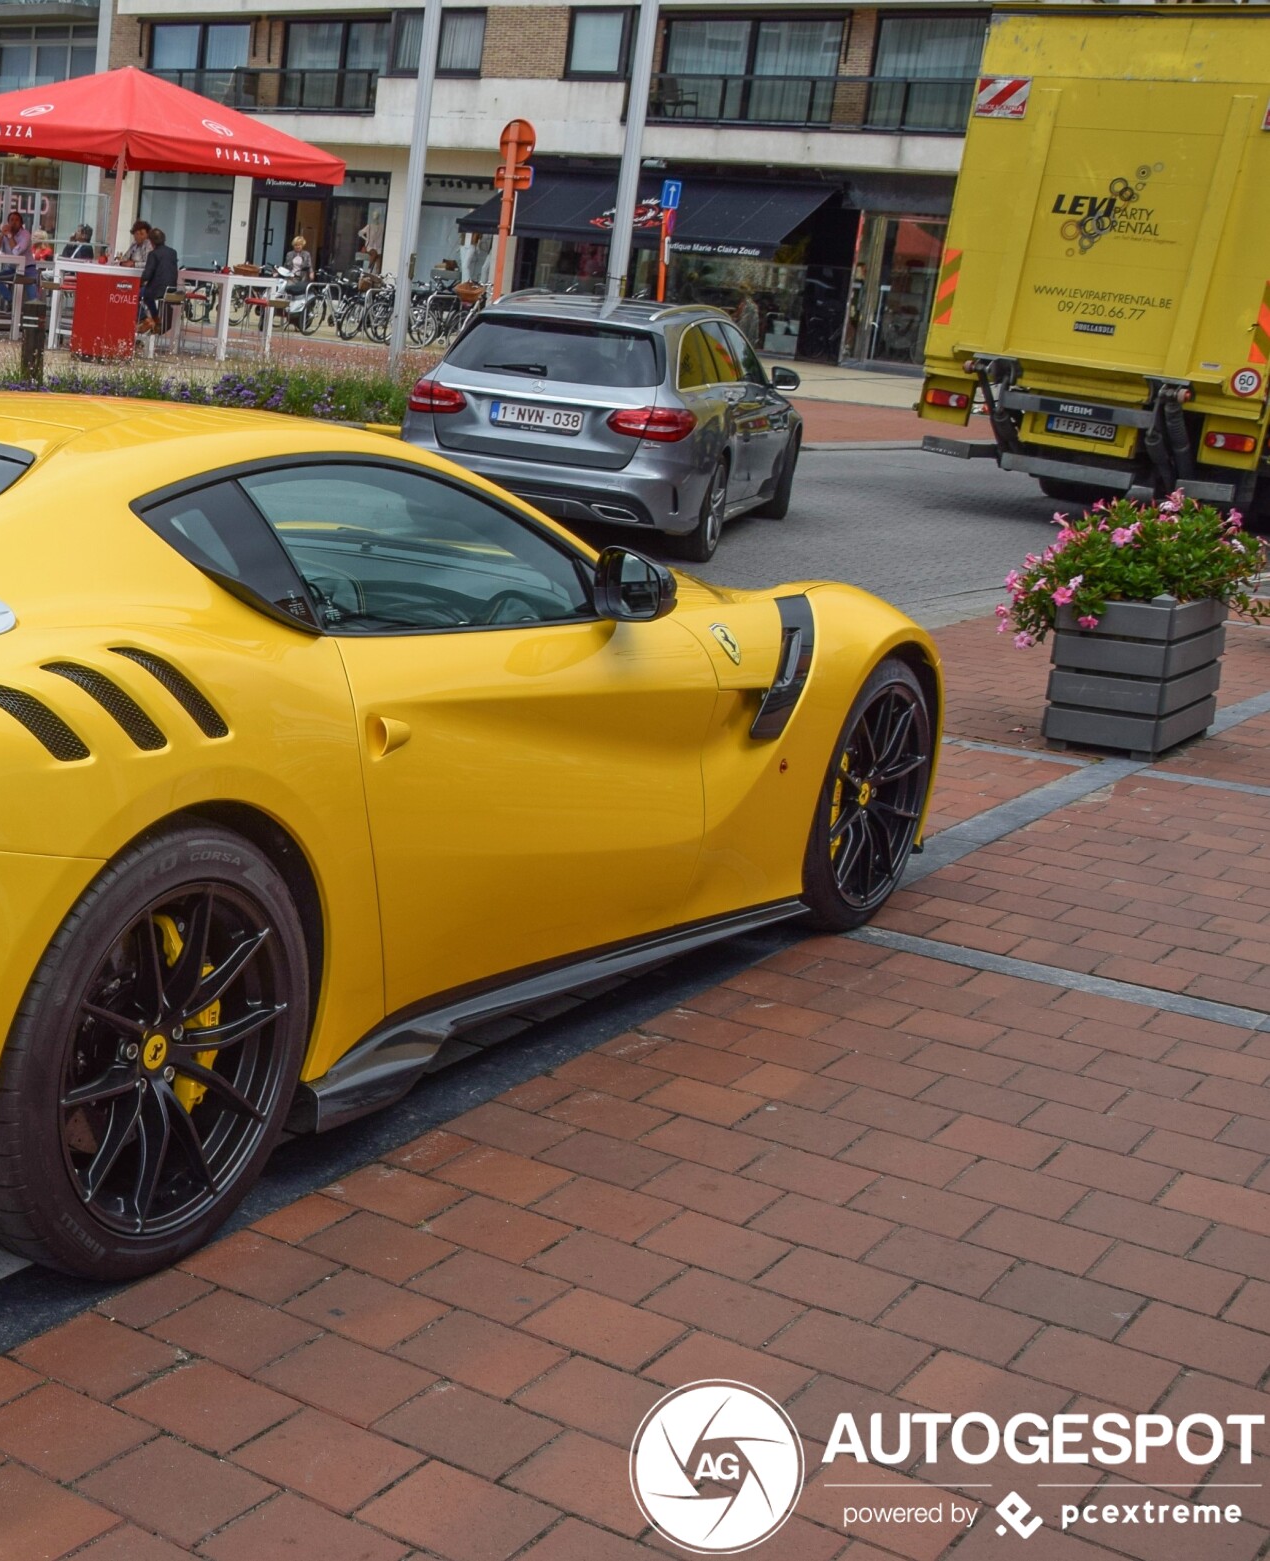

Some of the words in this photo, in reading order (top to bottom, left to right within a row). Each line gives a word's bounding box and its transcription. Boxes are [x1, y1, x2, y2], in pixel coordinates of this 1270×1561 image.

[215, 147, 271, 166] PIAZZA
[1051, 194, 1117, 217] LEVI
[1113, 207, 1154, 221] PARTY
[1110, 220, 1160, 236] RENTAL
[669, 241, 691, 251] utique
[692, 243, 712, 252] Marie
[717, 245, 738, 254] Claire
[738, 247, 760, 256] Zoute
[109, 293, 138, 305] ROYALE
[1033, 285, 1173, 309] WWW.LEVIPARTYRENTAL.BE
[1057, 300, 1146, 321] 09/230.66.77
[1238, 374, 1255, 386] 60
[1059, 404, 1093, 416] NEBIM
[189, 850, 242, 866] CORSA
